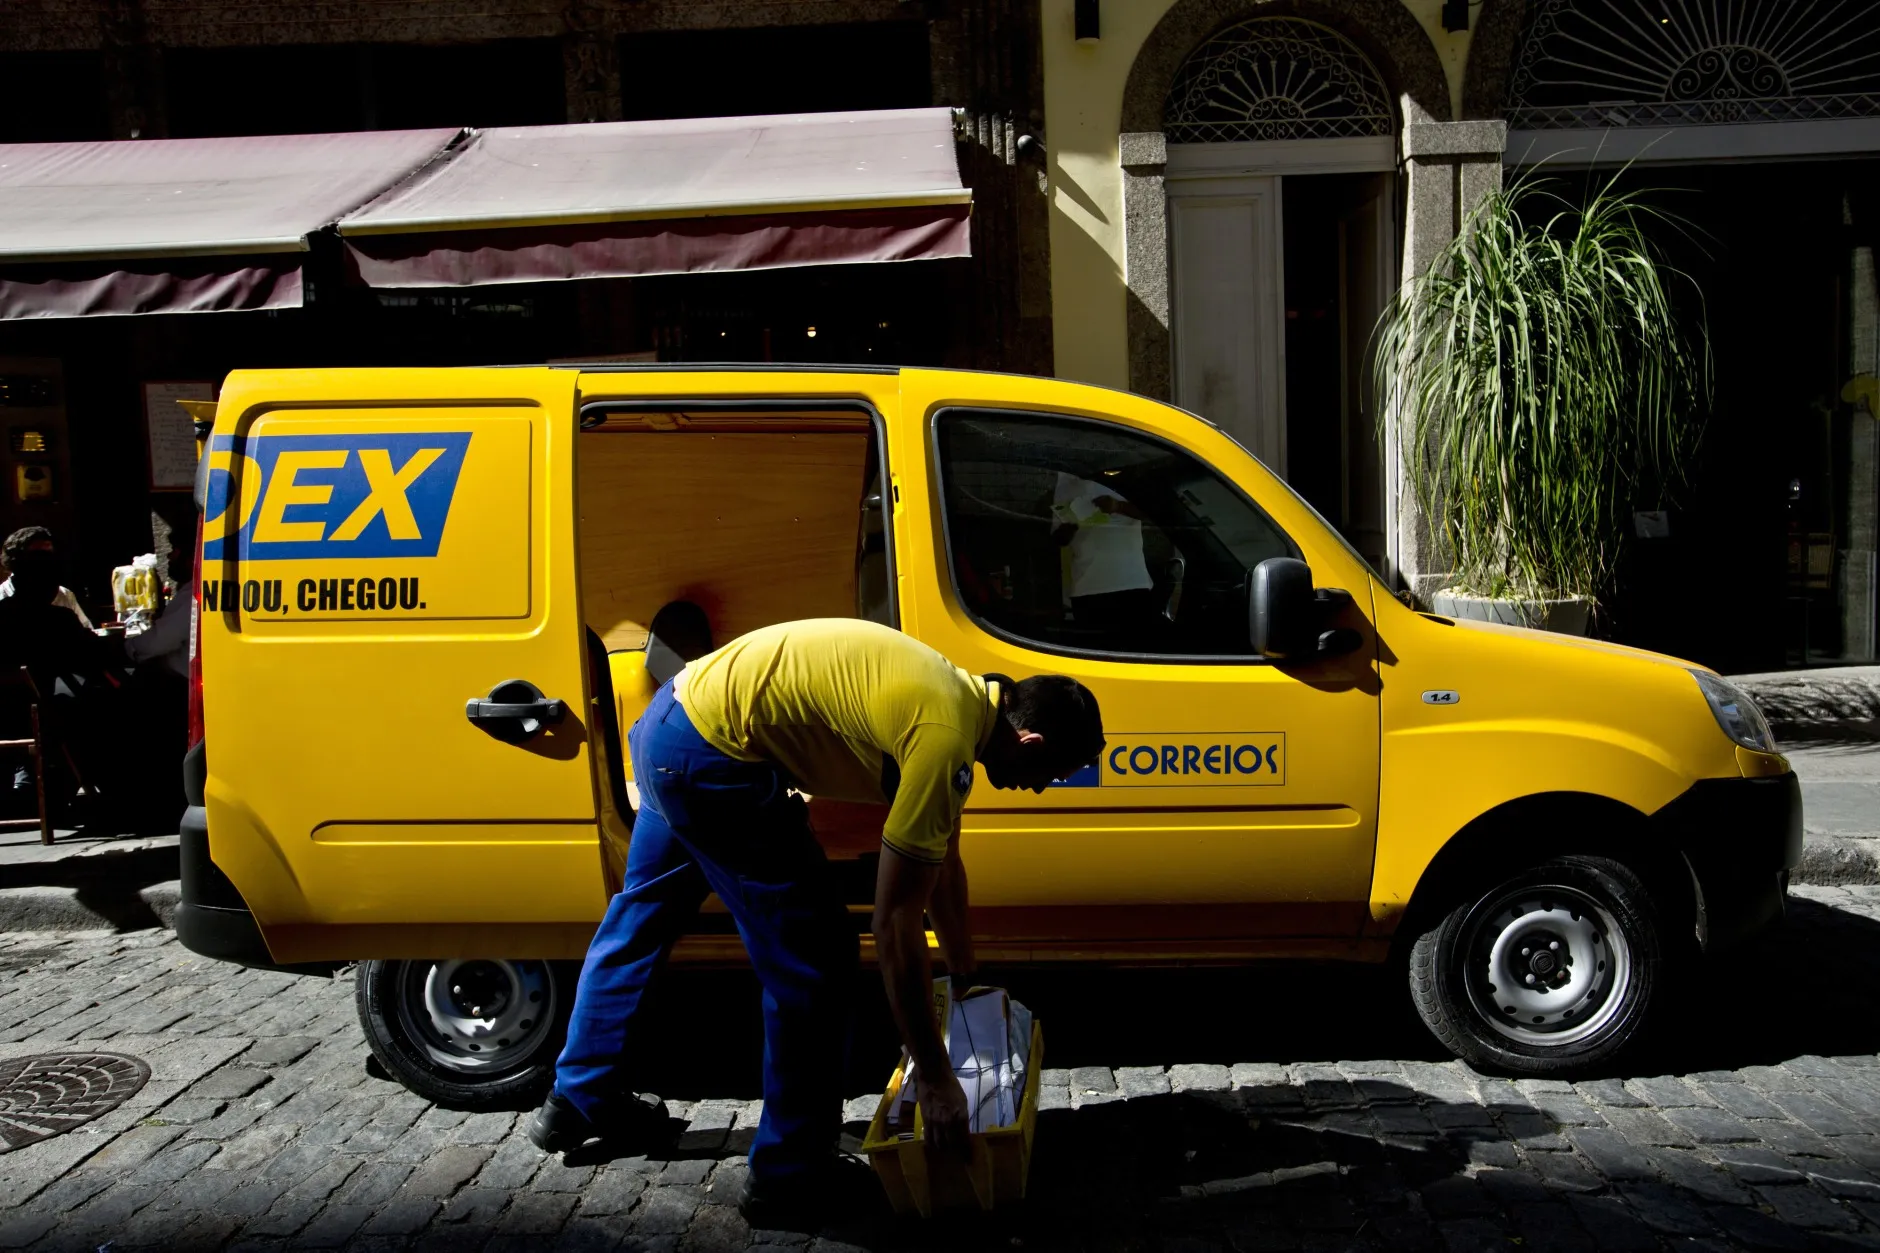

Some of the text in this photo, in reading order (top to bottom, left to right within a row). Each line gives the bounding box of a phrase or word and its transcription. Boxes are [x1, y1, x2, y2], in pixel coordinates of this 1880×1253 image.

[297, 577, 427, 612] CHEGOU.
[1430, 693, 1451, 702] 1.4
[1108, 744, 1278, 776] CORREIOS
